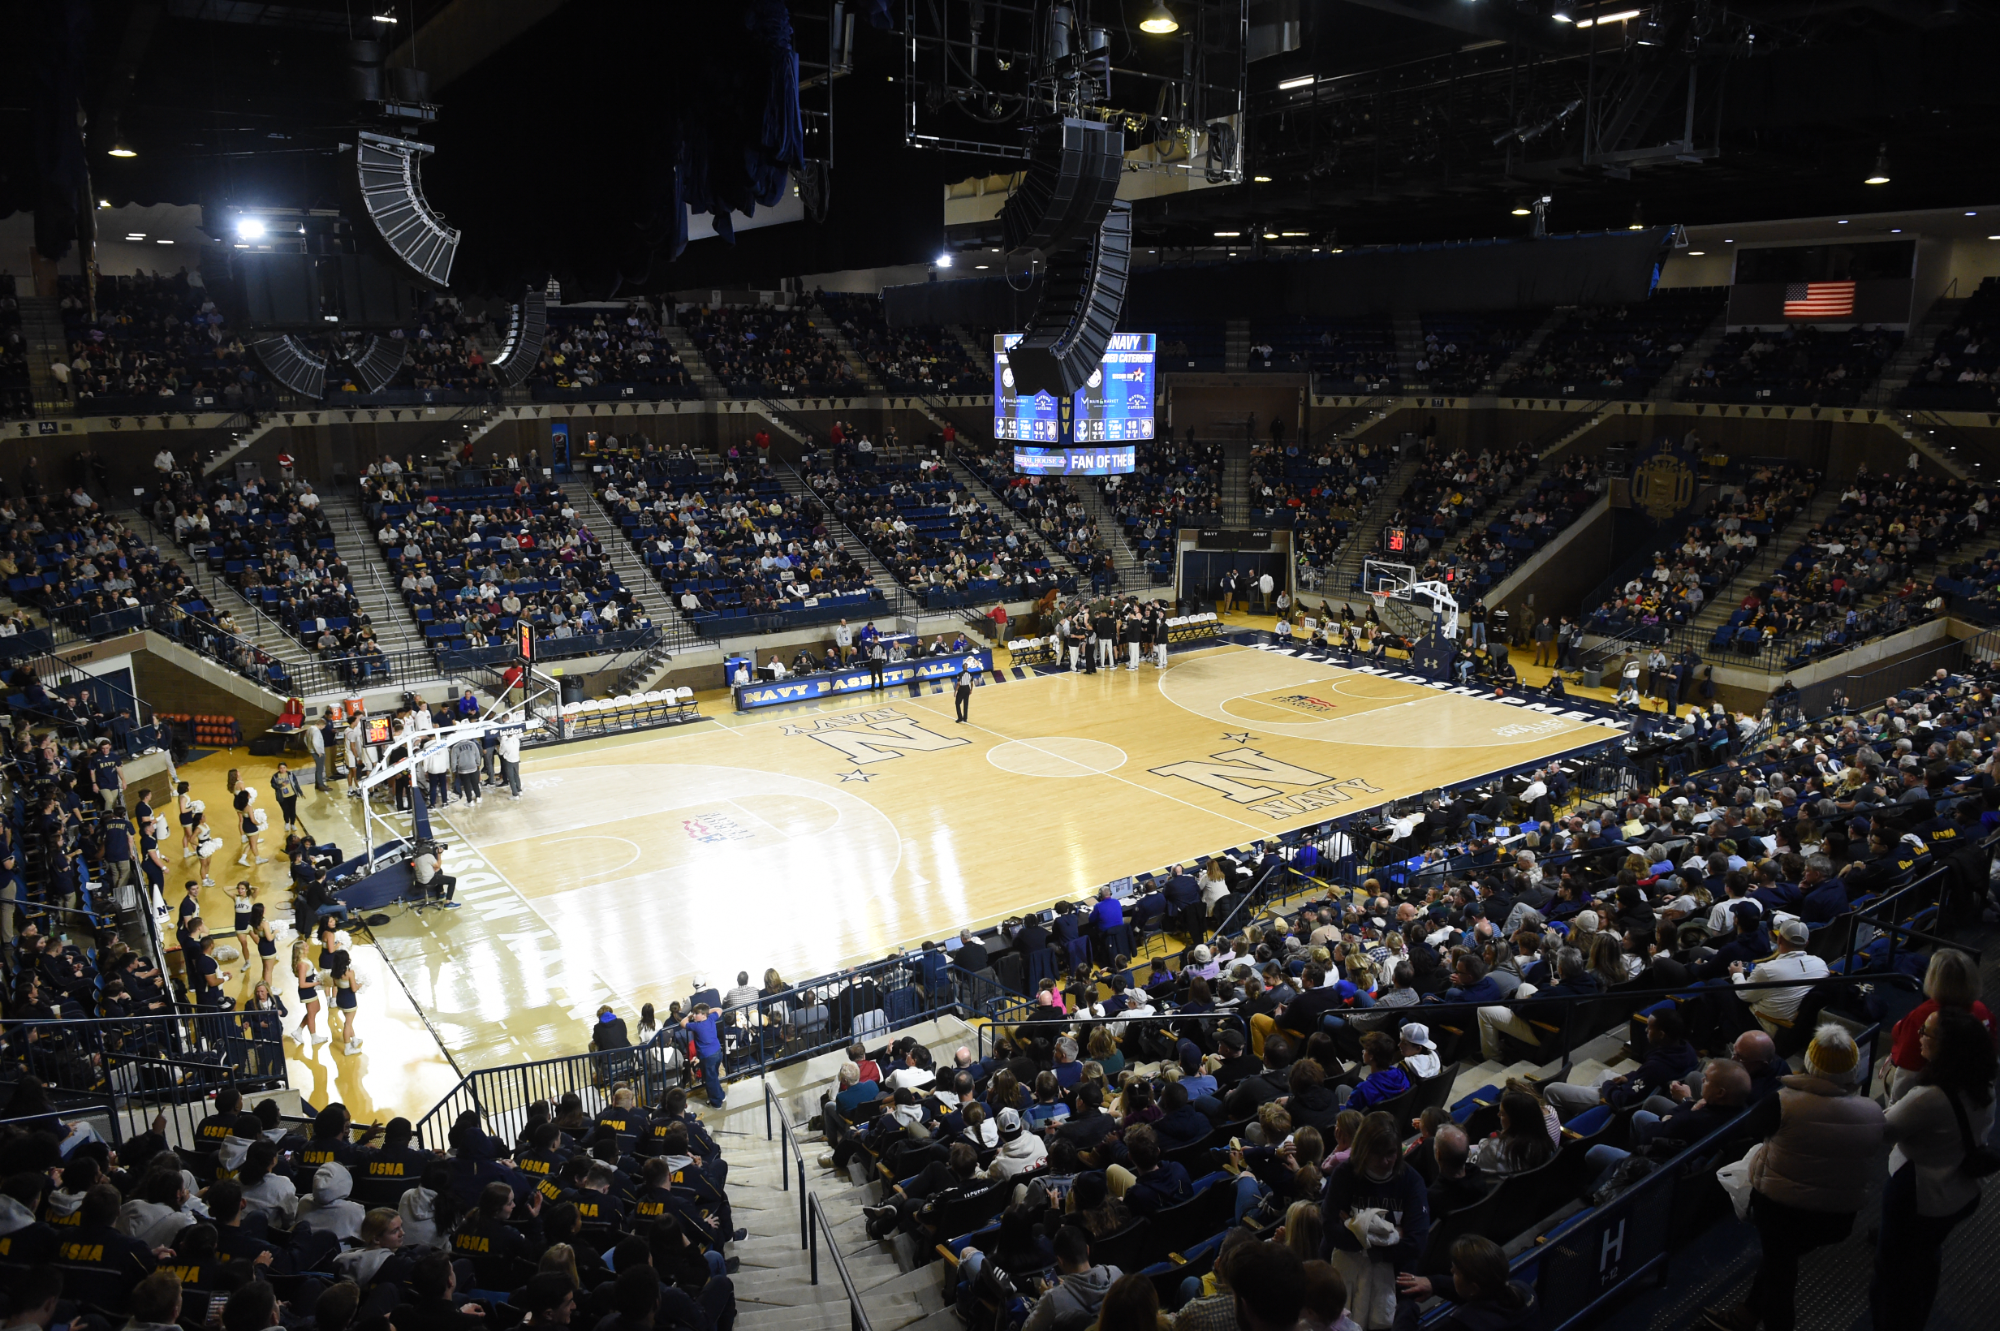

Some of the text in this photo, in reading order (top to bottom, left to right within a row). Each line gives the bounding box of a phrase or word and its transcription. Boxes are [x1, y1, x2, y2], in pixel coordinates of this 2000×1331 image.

[1119, 354, 1153, 363] CATERERS
[1071, 455, 1093, 469] FAN
[1097, 455, 1110, 468] OF
[1112, 454, 1127, 467] THE
[1390, 536, 1403, 550] 30
[65, 651, 93, 663] LOBBY
[1249, 642, 1350, 665] NAVY
[1347, 664, 1630, 729] MIDSHIPMEN
[744, 684, 808, 704] NAVY
[370, 719, 389, 728] 7:54
[370, 729, 386, 741] 30
[500, 727, 523, 736] leidos
[807, 717, 972, 765] N
[100, 761, 116, 769] NAVY
[1146, 746, 1336, 804] N
[1247, 777, 1384, 820] NAVY
[1932, 828, 1957, 840] USNA
[156, 906, 167, 916] N
[203, 1125, 234, 1138] USNA
[654, 1126, 667, 1137] US
[303, 1151, 335, 1164] USNA
[369, 1162, 404, 1176] USNA
[520, 1158, 550, 1174] USNA
[566, 1200, 599, 1217] NA
[637, 1202, 664, 1216] USNA
[456, 1234, 489, 1253] USNA
[1599, 1218, 1625, 1273] H
[59, 1242, 104, 1262] USNA
[1601, 1266, 1619, 1286] 1-12
